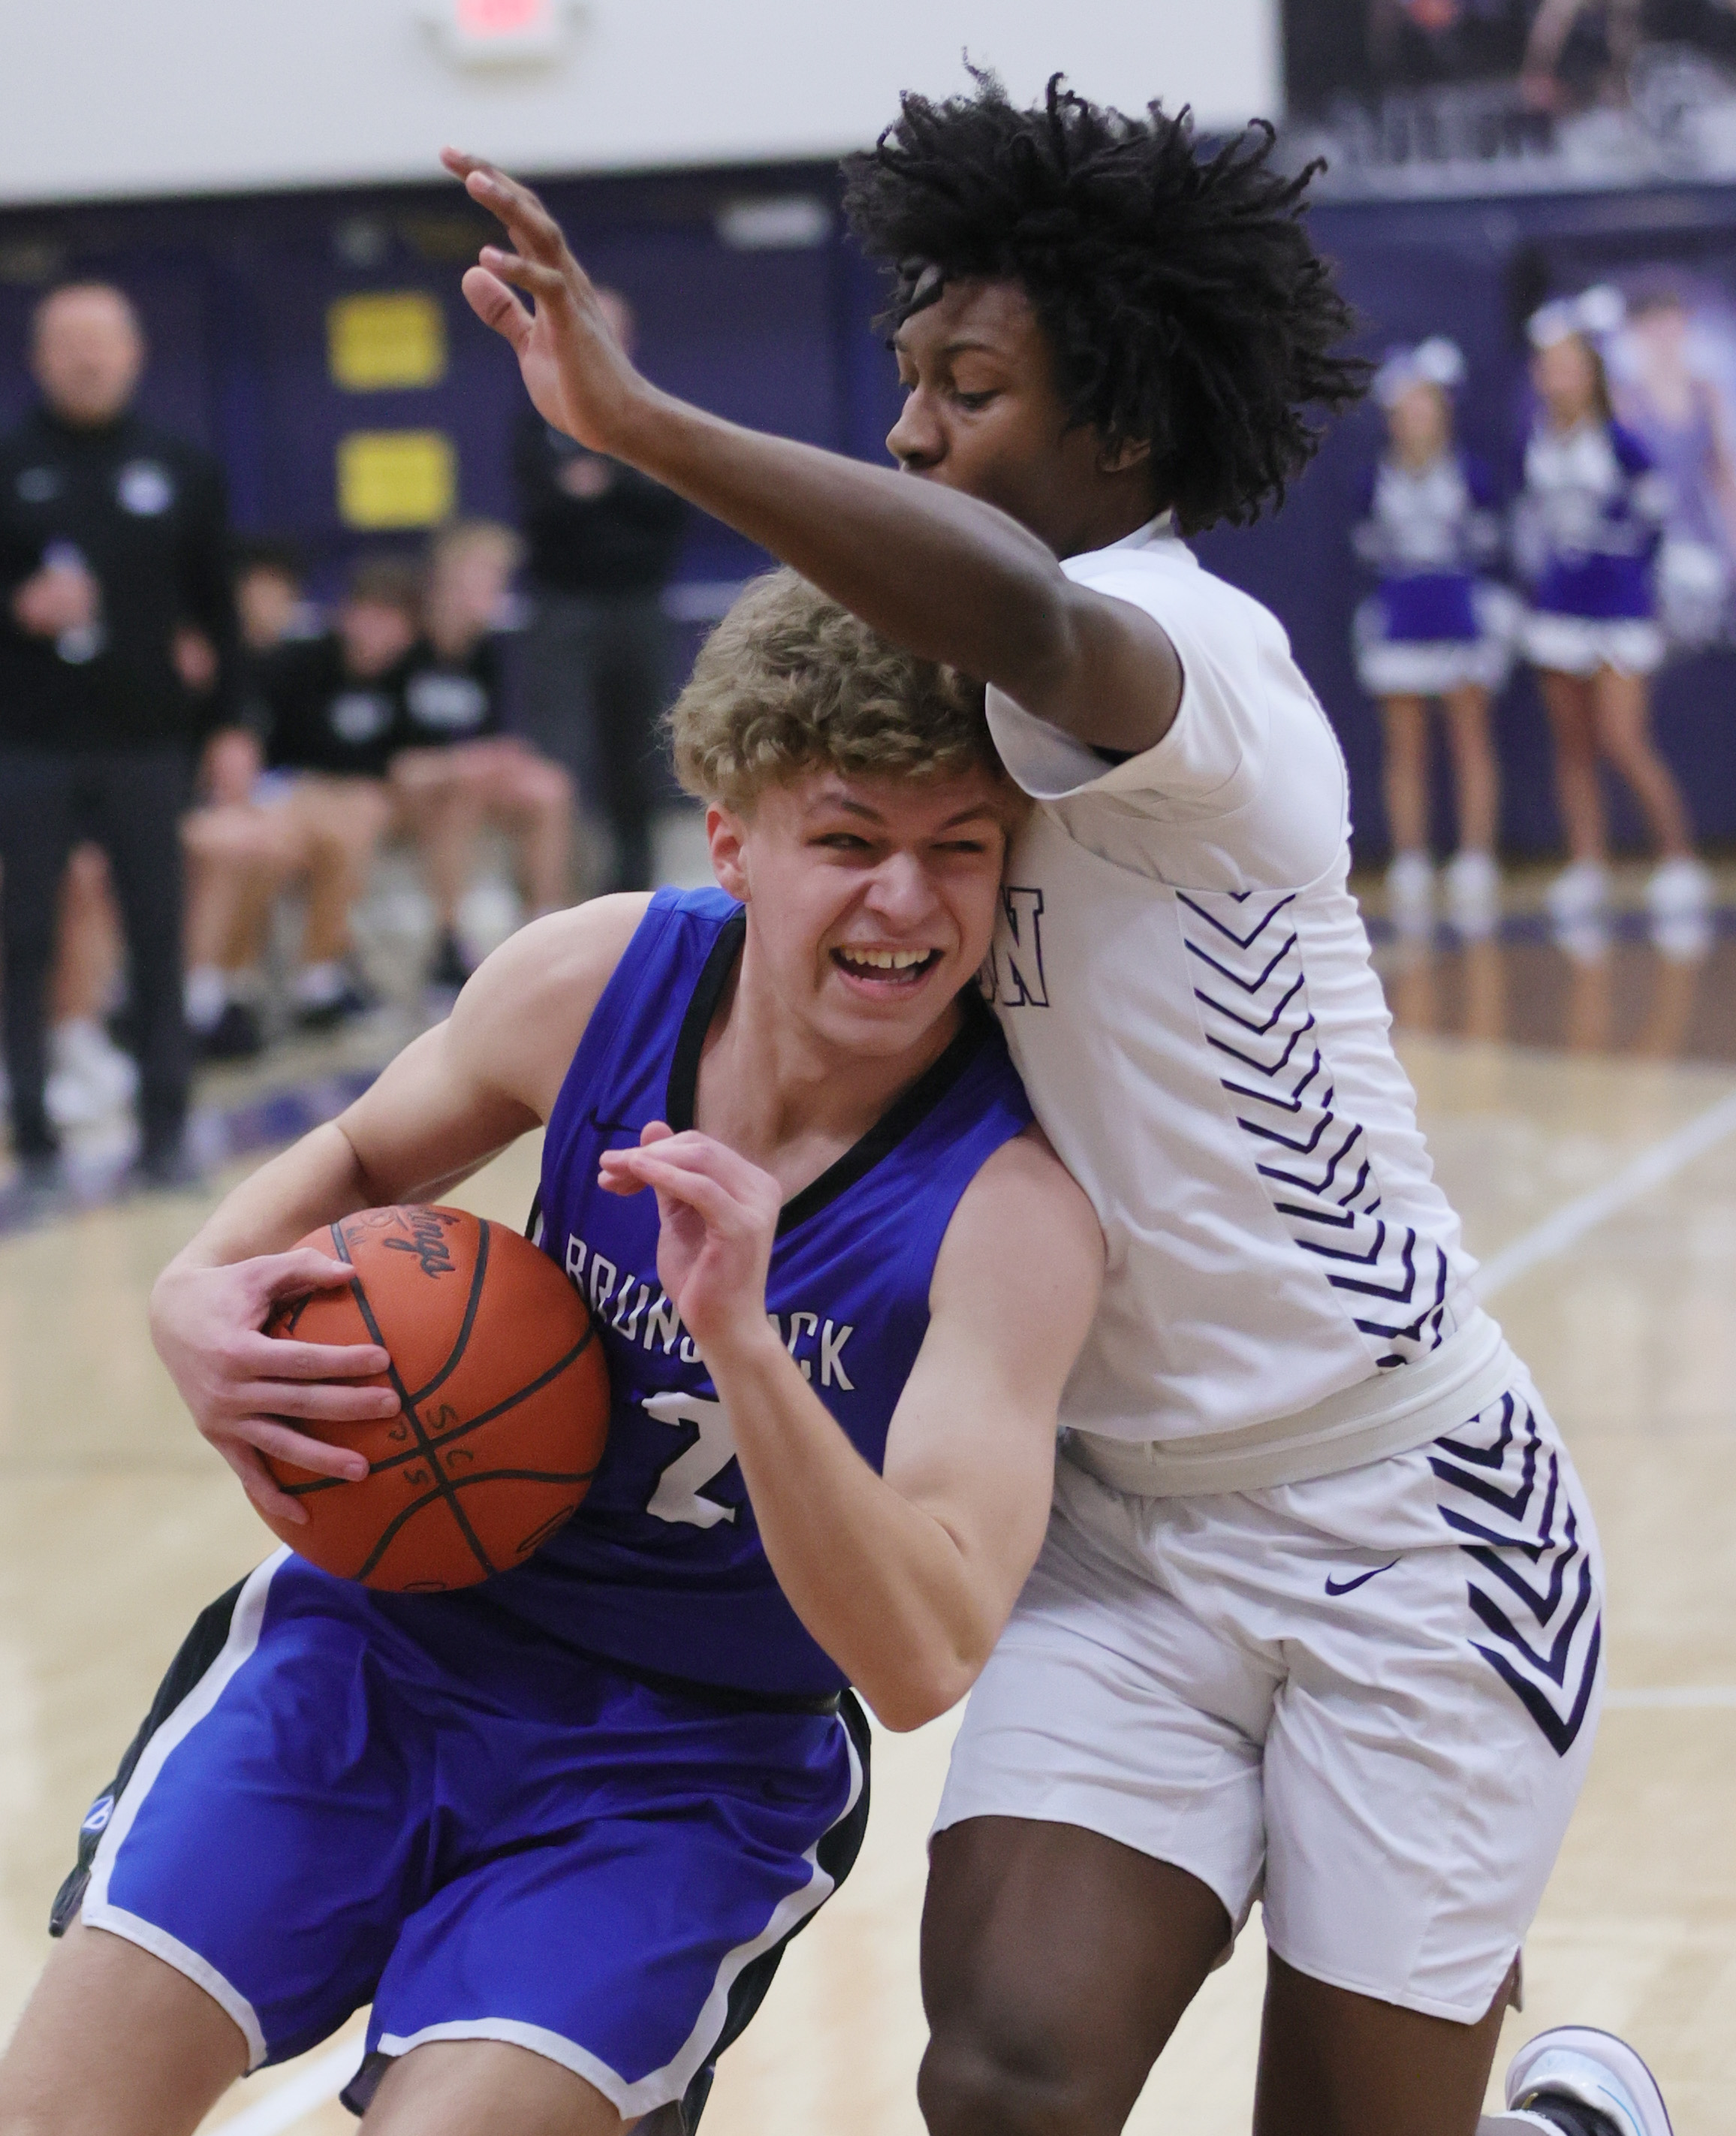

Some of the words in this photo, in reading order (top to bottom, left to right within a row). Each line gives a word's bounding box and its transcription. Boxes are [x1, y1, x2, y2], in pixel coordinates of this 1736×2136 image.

[978, 886, 1050, 1007] N
[565, 1232, 855, 1391] BRUNCK
[641, 1391, 737, 1529] 2
